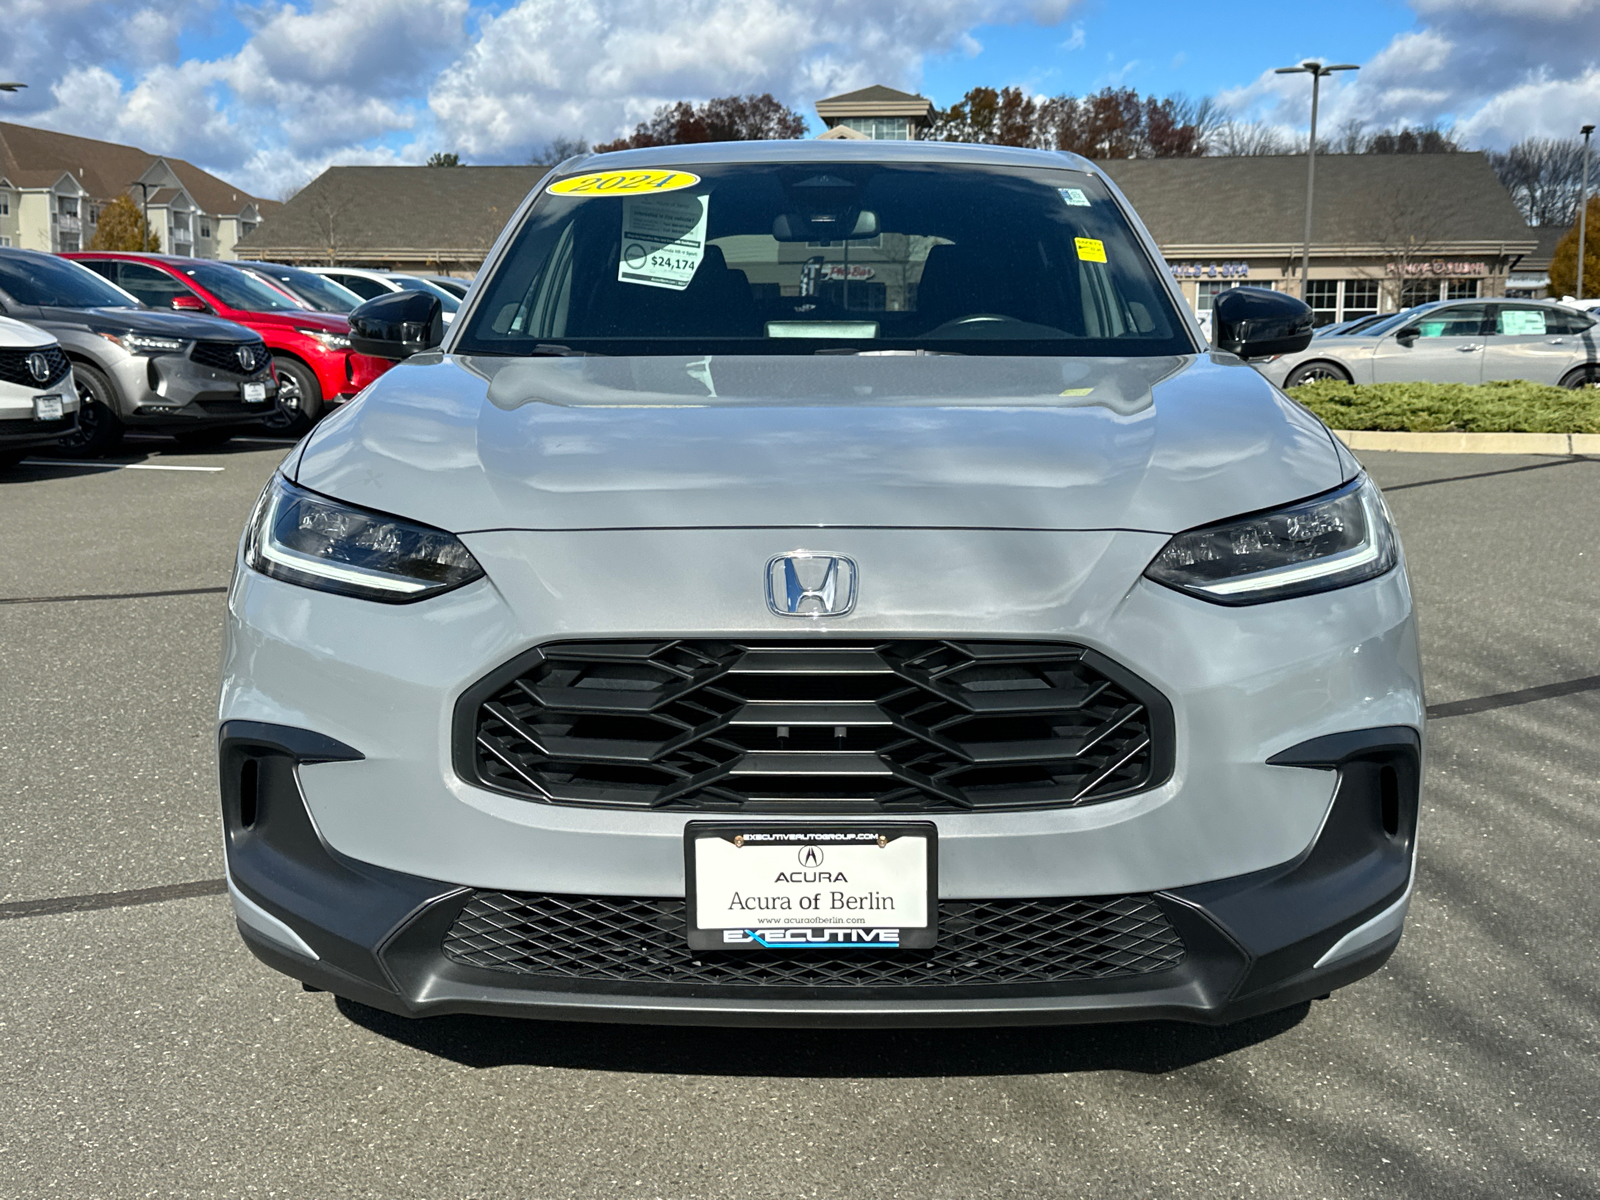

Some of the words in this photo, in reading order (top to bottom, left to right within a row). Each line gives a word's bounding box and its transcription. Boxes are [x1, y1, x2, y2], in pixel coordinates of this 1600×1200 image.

[568, 173, 677, 192] 2024
[651, 255, 695, 271] $24,174
[1167, 262, 1202, 276] AILS
[1222, 263, 1248, 276] SPA
[743, 833, 879, 841] EXECUTIVEAUTOGROUP.COM
[774, 871, 849, 883] ACURA
[728, 891, 792, 910] Acura
[799, 893, 821, 910] of
[829, 891, 895, 910] Berlin
[757, 916, 866, 924] www.acuraofberlin.com
[723, 928, 900, 944] EXECUTIVE
